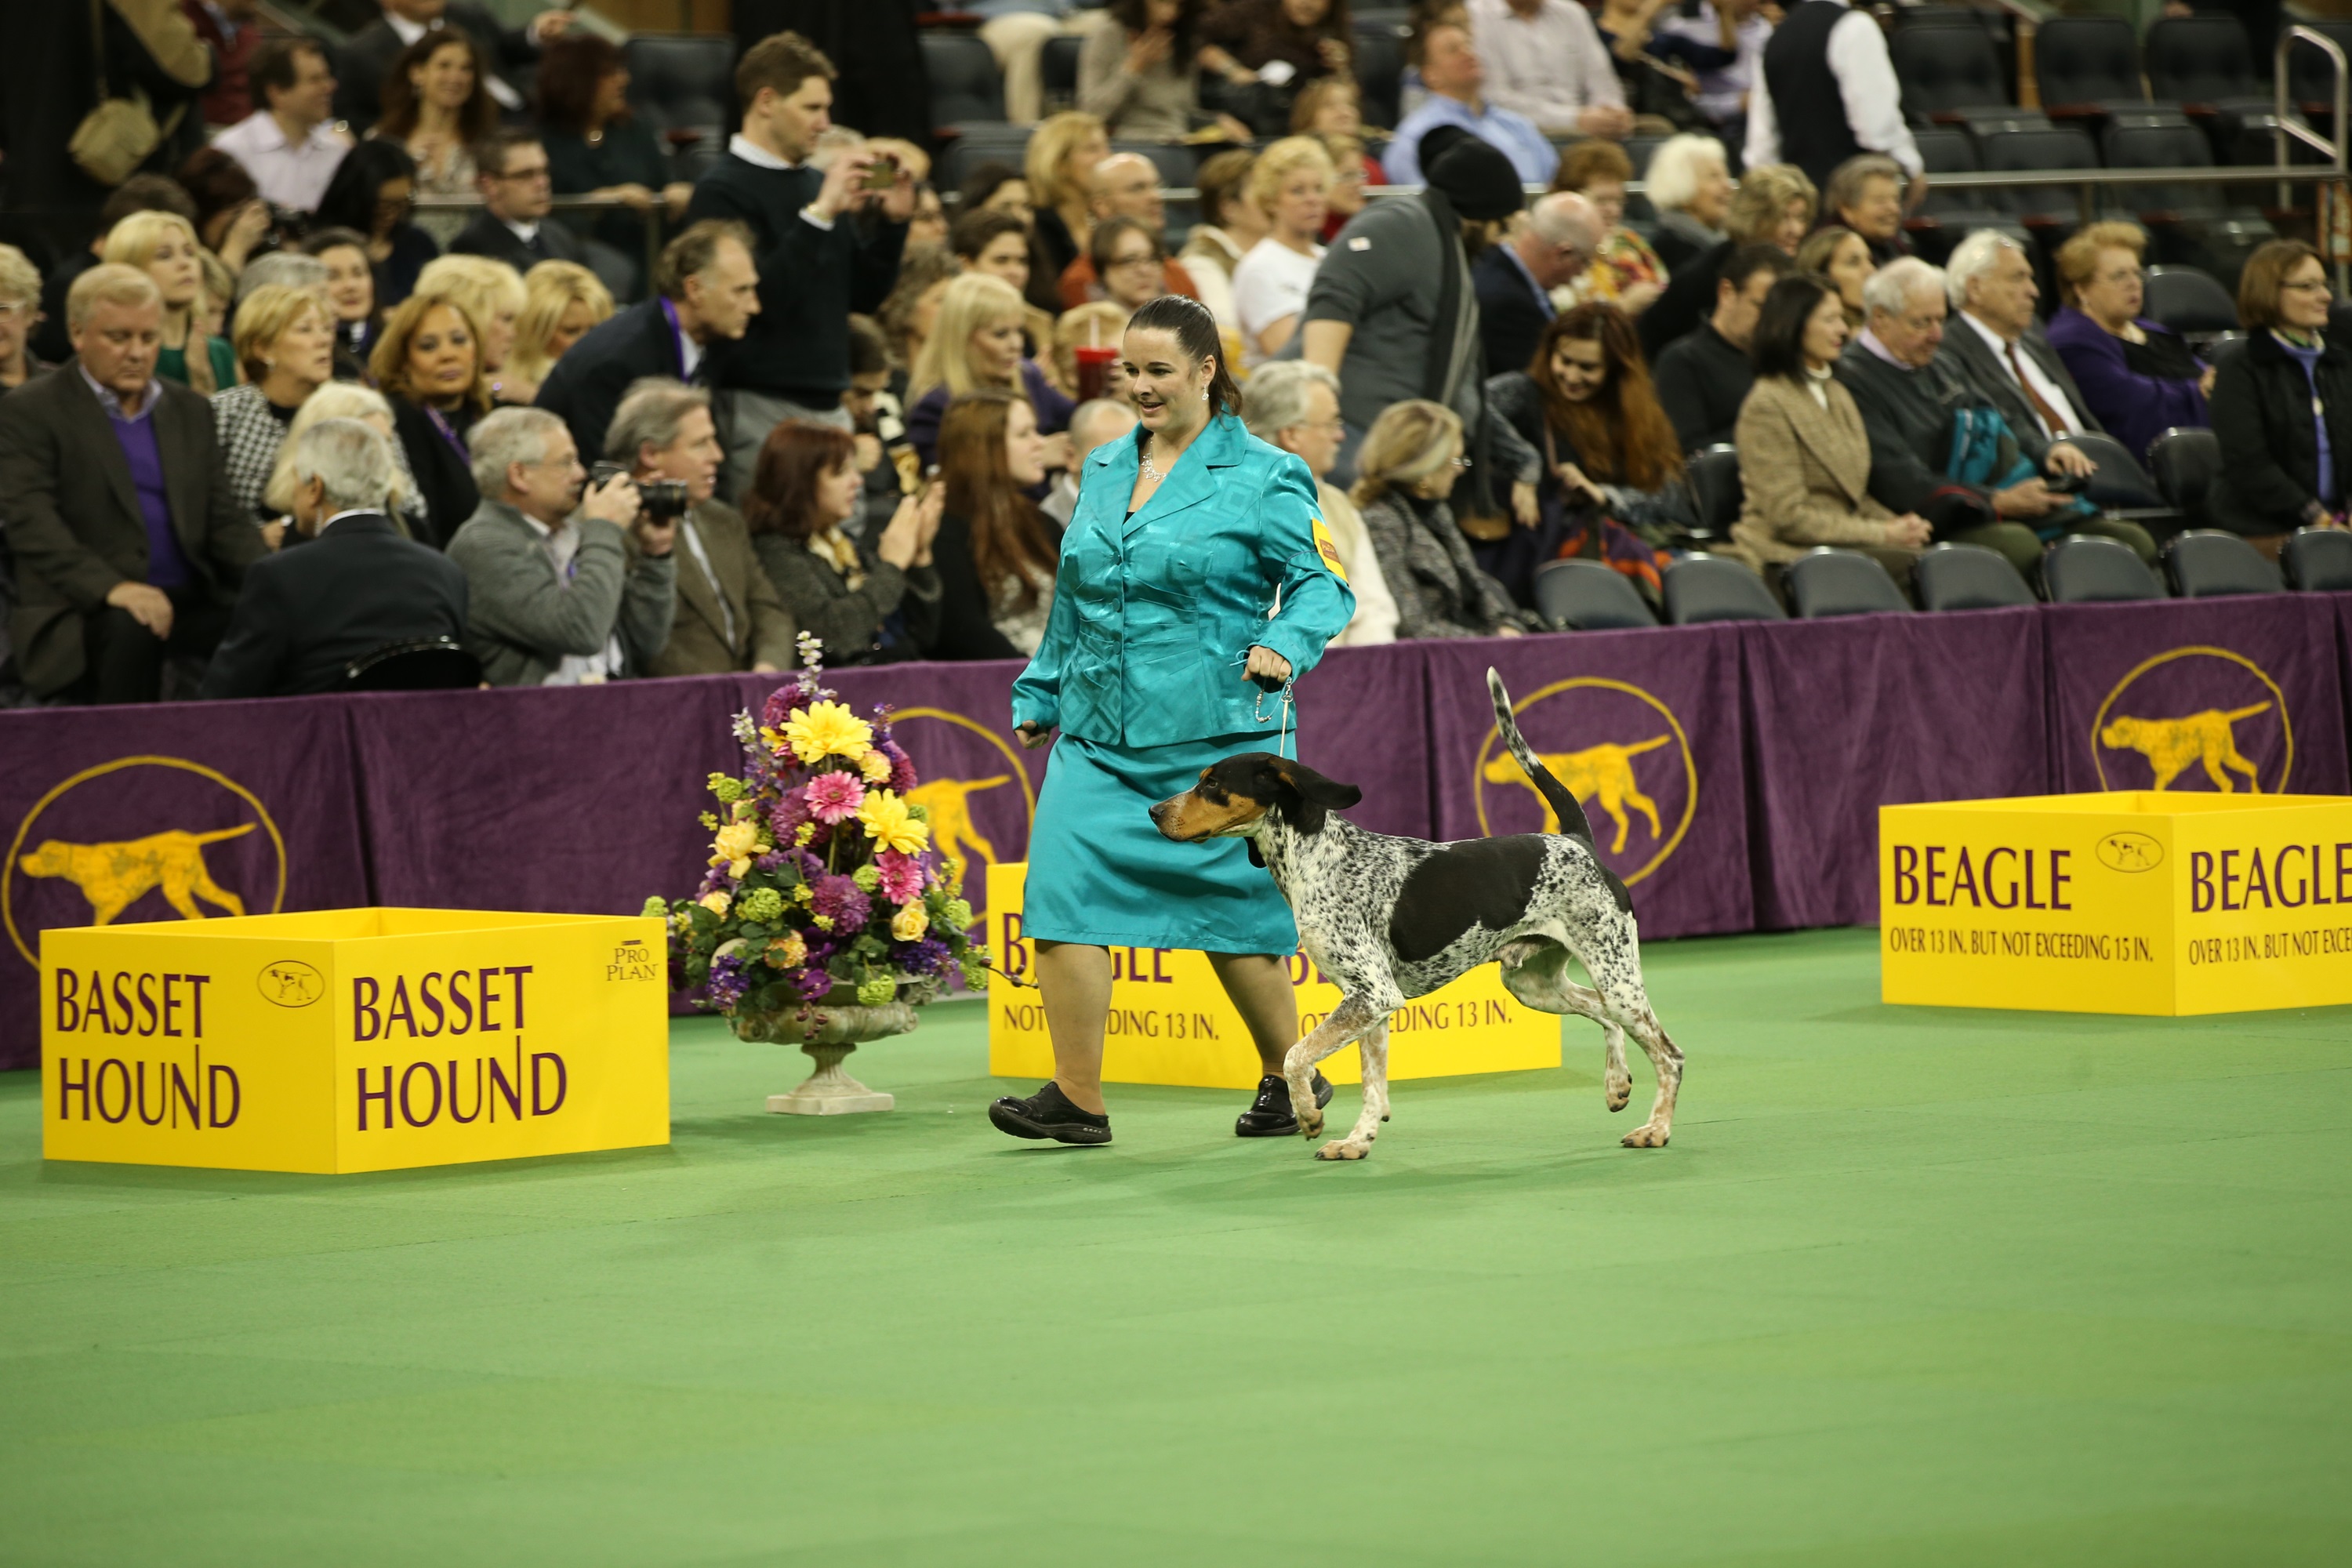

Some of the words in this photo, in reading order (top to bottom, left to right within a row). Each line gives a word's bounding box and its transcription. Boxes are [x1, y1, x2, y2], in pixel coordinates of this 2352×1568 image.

[1893, 844, 2071, 910] BEAGLE
[2190, 843, 2352, 913] BEAGLE
[614, 947, 649, 964] PRO
[1890, 927, 1926, 953] OVER
[1930, 929, 1944, 954] 13
[1949, 929, 1967, 955] IN.
[1972, 930, 1998, 956] BUT
[2002, 931, 2031, 956] NOT
[2036, 933, 2110, 960] EXCEEDING
[2115, 937, 2129, 962] 15
[2134, 937, 2154, 963] IN.
[2189, 938, 2223, 965] OVER
[2227, 937, 2240, 962] 13
[2244, 935, 2261, 960] IN.
[2265, 933, 2288, 959] BUT
[2292, 931, 2319, 956] NOT
[606, 964, 659, 982] PLAN
[56, 967, 210, 1038] BASSET
[353, 965, 533, 1042] BASSET
[1004, 1004, 1044, 1031] NOT
[1165, 1013, 1185, 1039] 13
[1192, 1013, 1219, 1040] IN.
[1457, 1001, 1478, 1028] 13
[1486, 999, 1512, 1025] IN.
[60, 1044, 241, 1130] HOUND
[358, 1036, 567, 1131] HOUND
